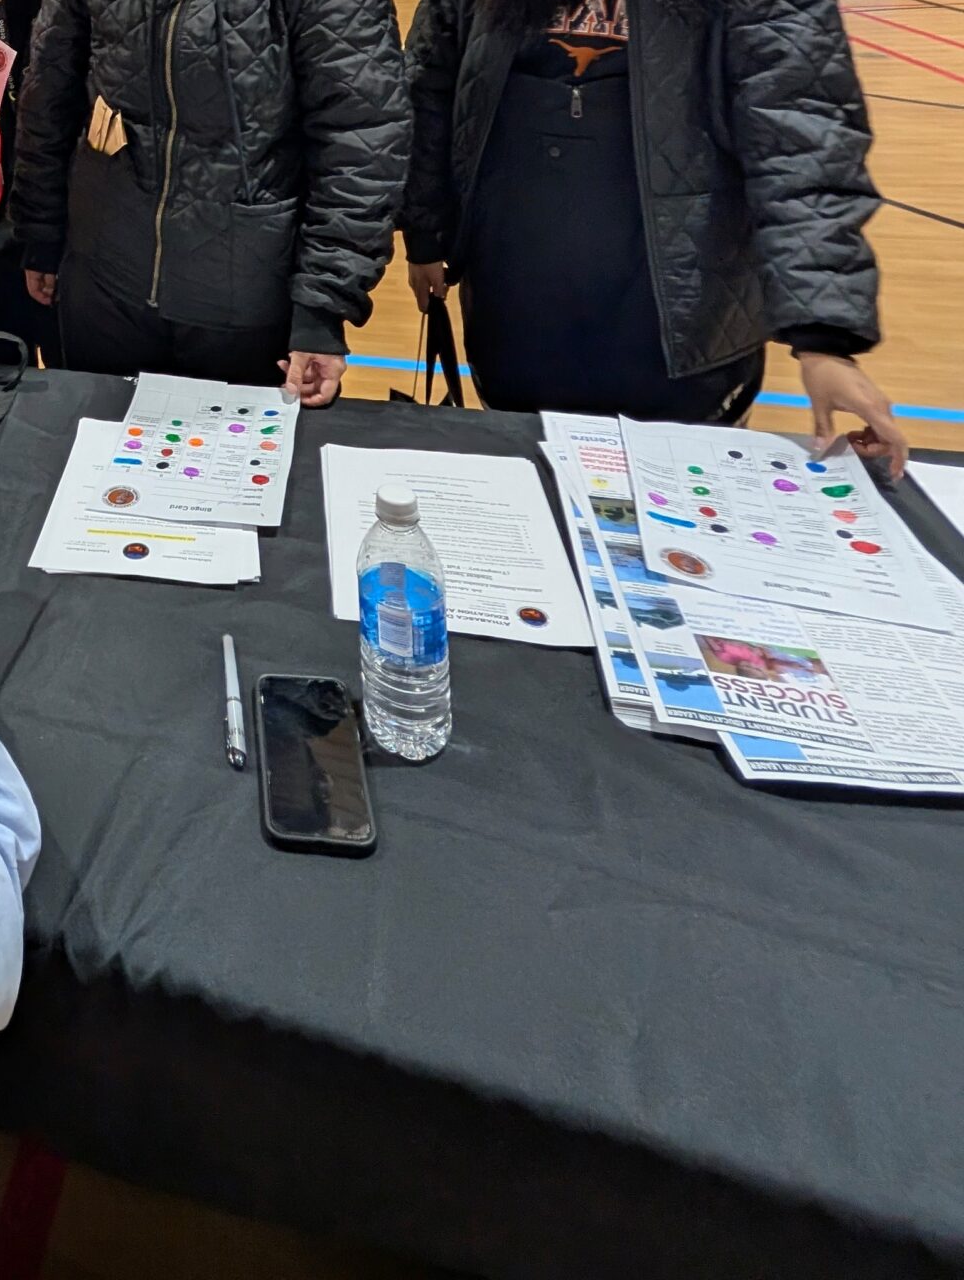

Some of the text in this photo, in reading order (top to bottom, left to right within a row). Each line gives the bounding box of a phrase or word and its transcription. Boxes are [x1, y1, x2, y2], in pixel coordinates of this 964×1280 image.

[571, 436, 618, 446] Centre
[458, 609, 509, 620] EDUCATION
[456, 615, 510, 626] ATHABASCA
[712, 675, 848, 709] SUCCESS
[666, 709, 696, 718] LEADER
[722, 690, 858, 726] STUDENT
[698, 714, 743, 728] EDUCATION
[749, 761, 781, 771] LEADER
